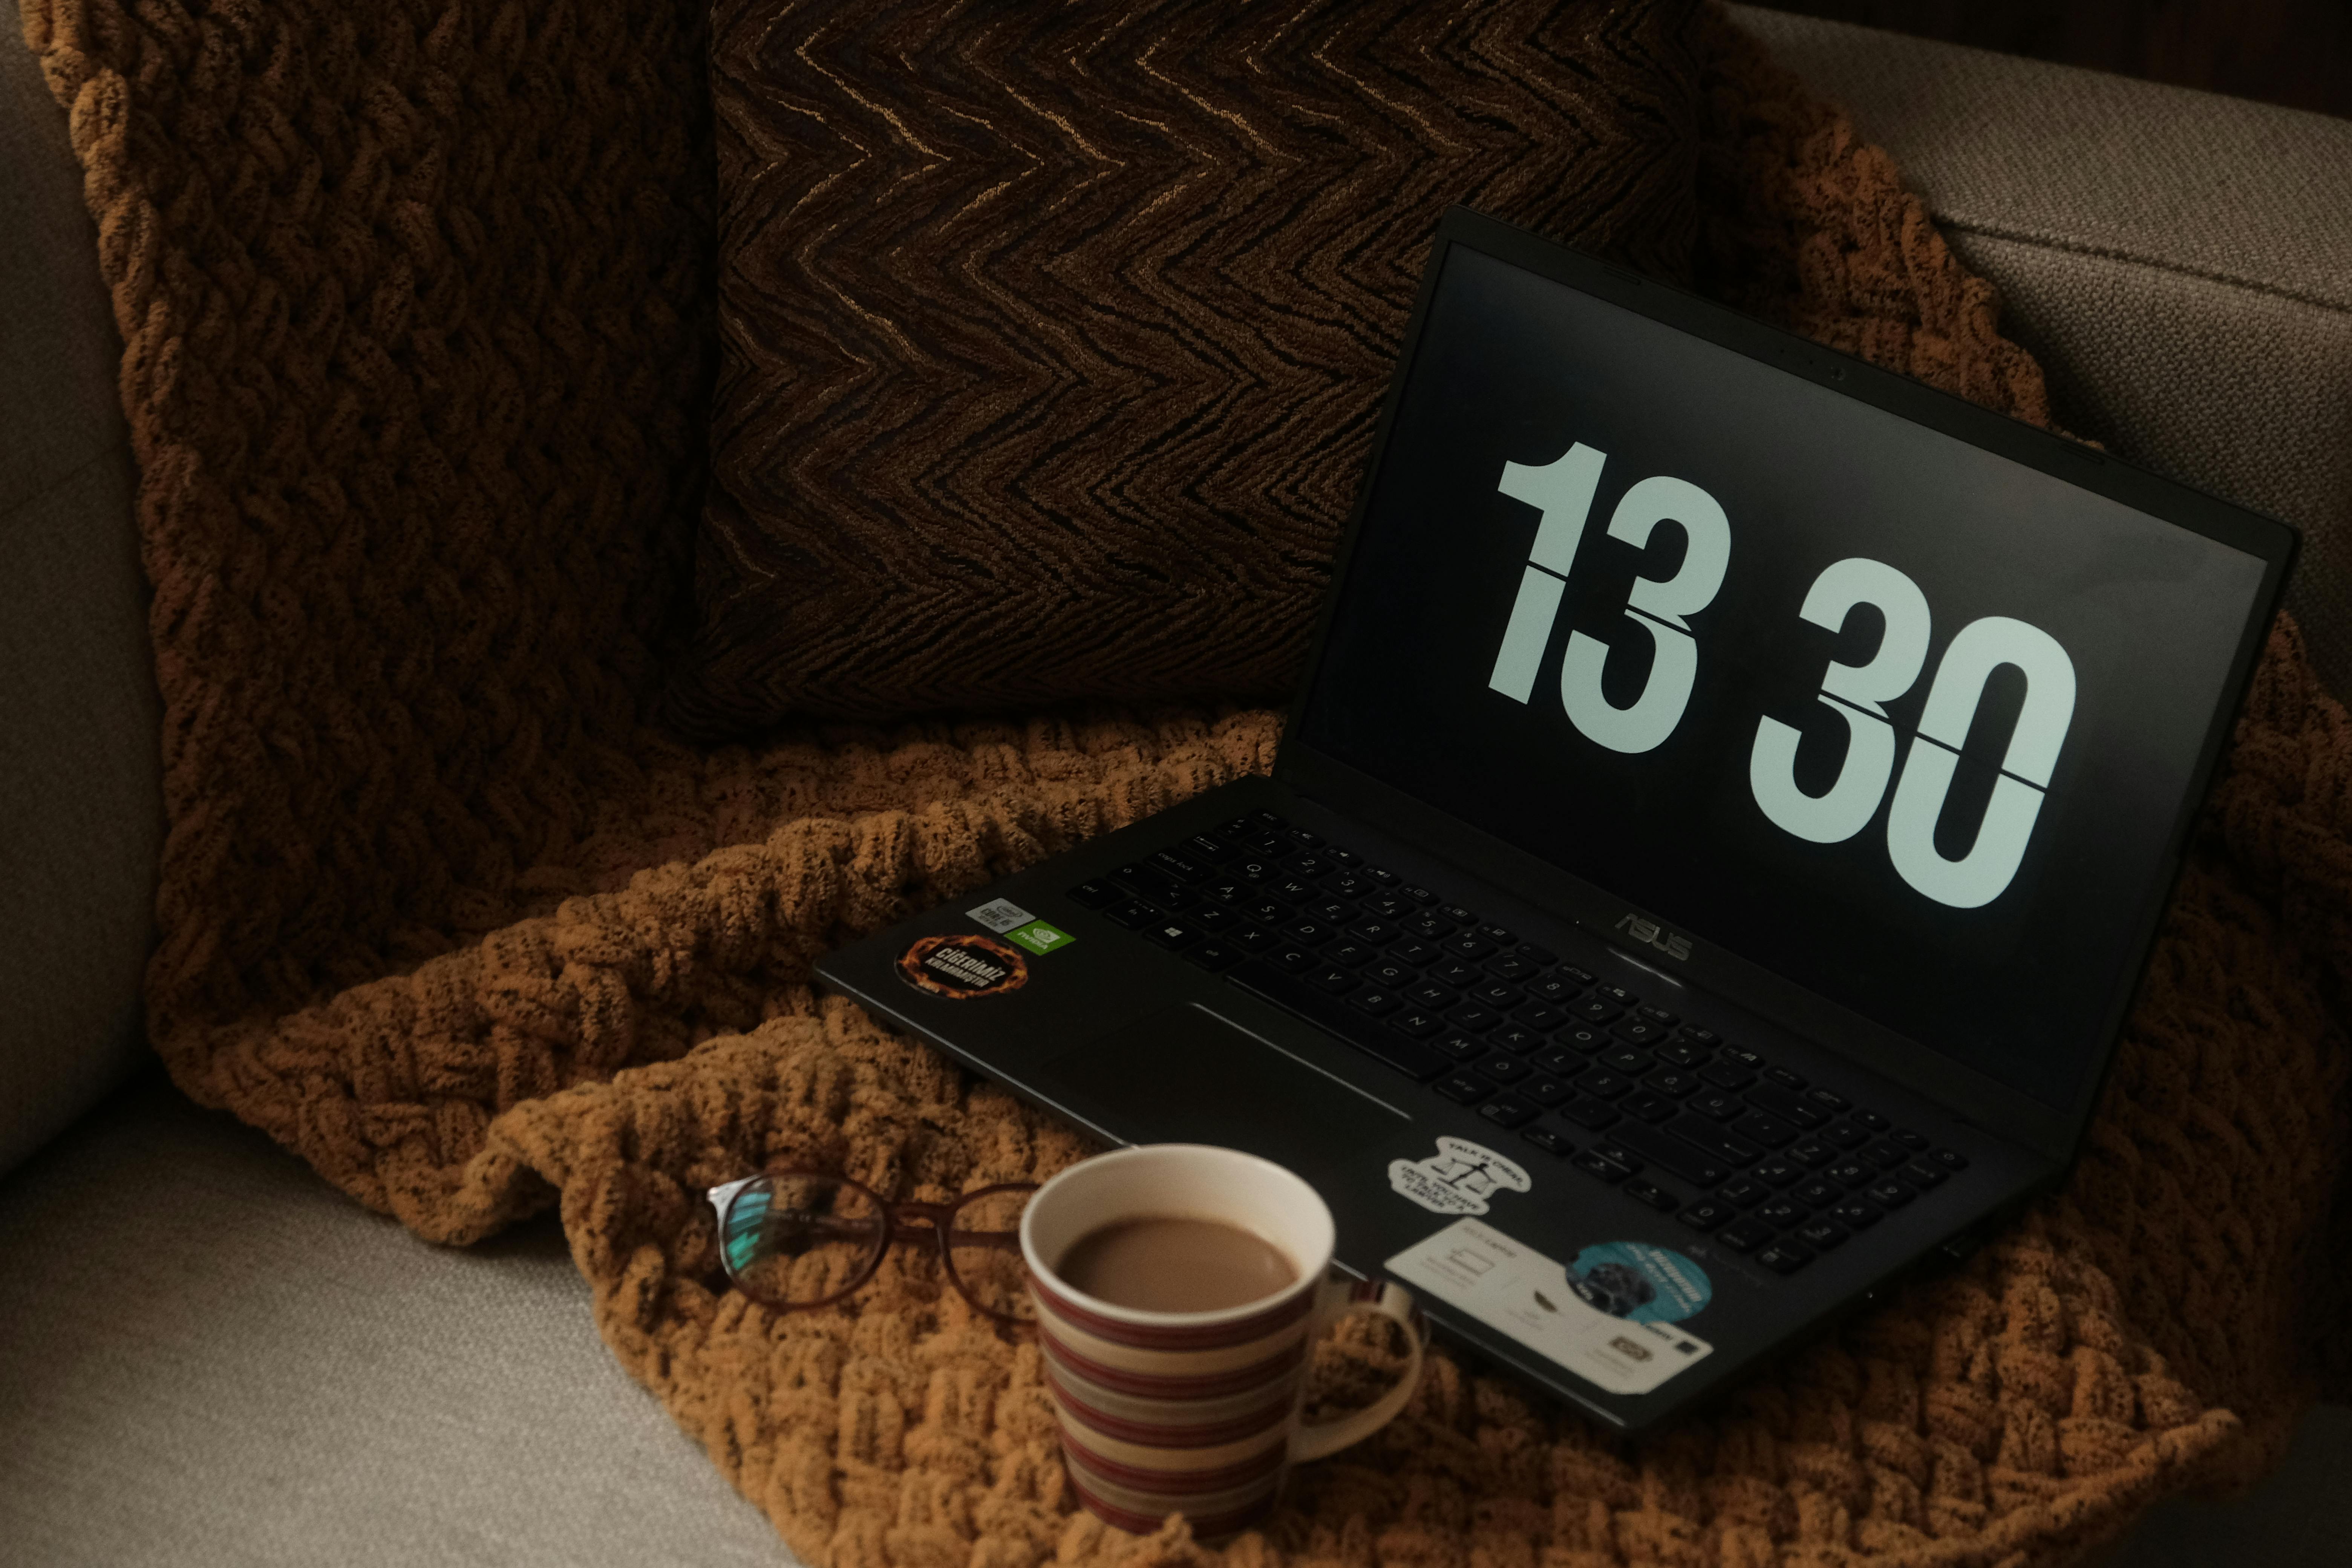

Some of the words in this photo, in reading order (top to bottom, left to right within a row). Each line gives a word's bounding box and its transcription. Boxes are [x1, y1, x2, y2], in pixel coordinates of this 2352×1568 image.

[1488, 441, 1732, 755] 13
[1749, 557, 2076, 910] 30
[1158, 853, 1177, 863] caps
[1176, 862, 1193, 871] lock
[1246, 864, 1262, 872] Q
[1285, 882, 1303, 891] W
[1018, 931, 1048, 949] NVIDIA
[1615, 913, 1693, 961] ASUS
[935, 948, 1007, 981] CİĞERİMİZ
[1424, 989, 1441, 997] H
[1490, 988, 1507, 997] U
[1409, 1017, 1426, 1026] N
[1509, 1033, 1524, 1041] K
[1575, 1031, 1592, 1040] O
[1450, 1039, 1468, 1049] M
